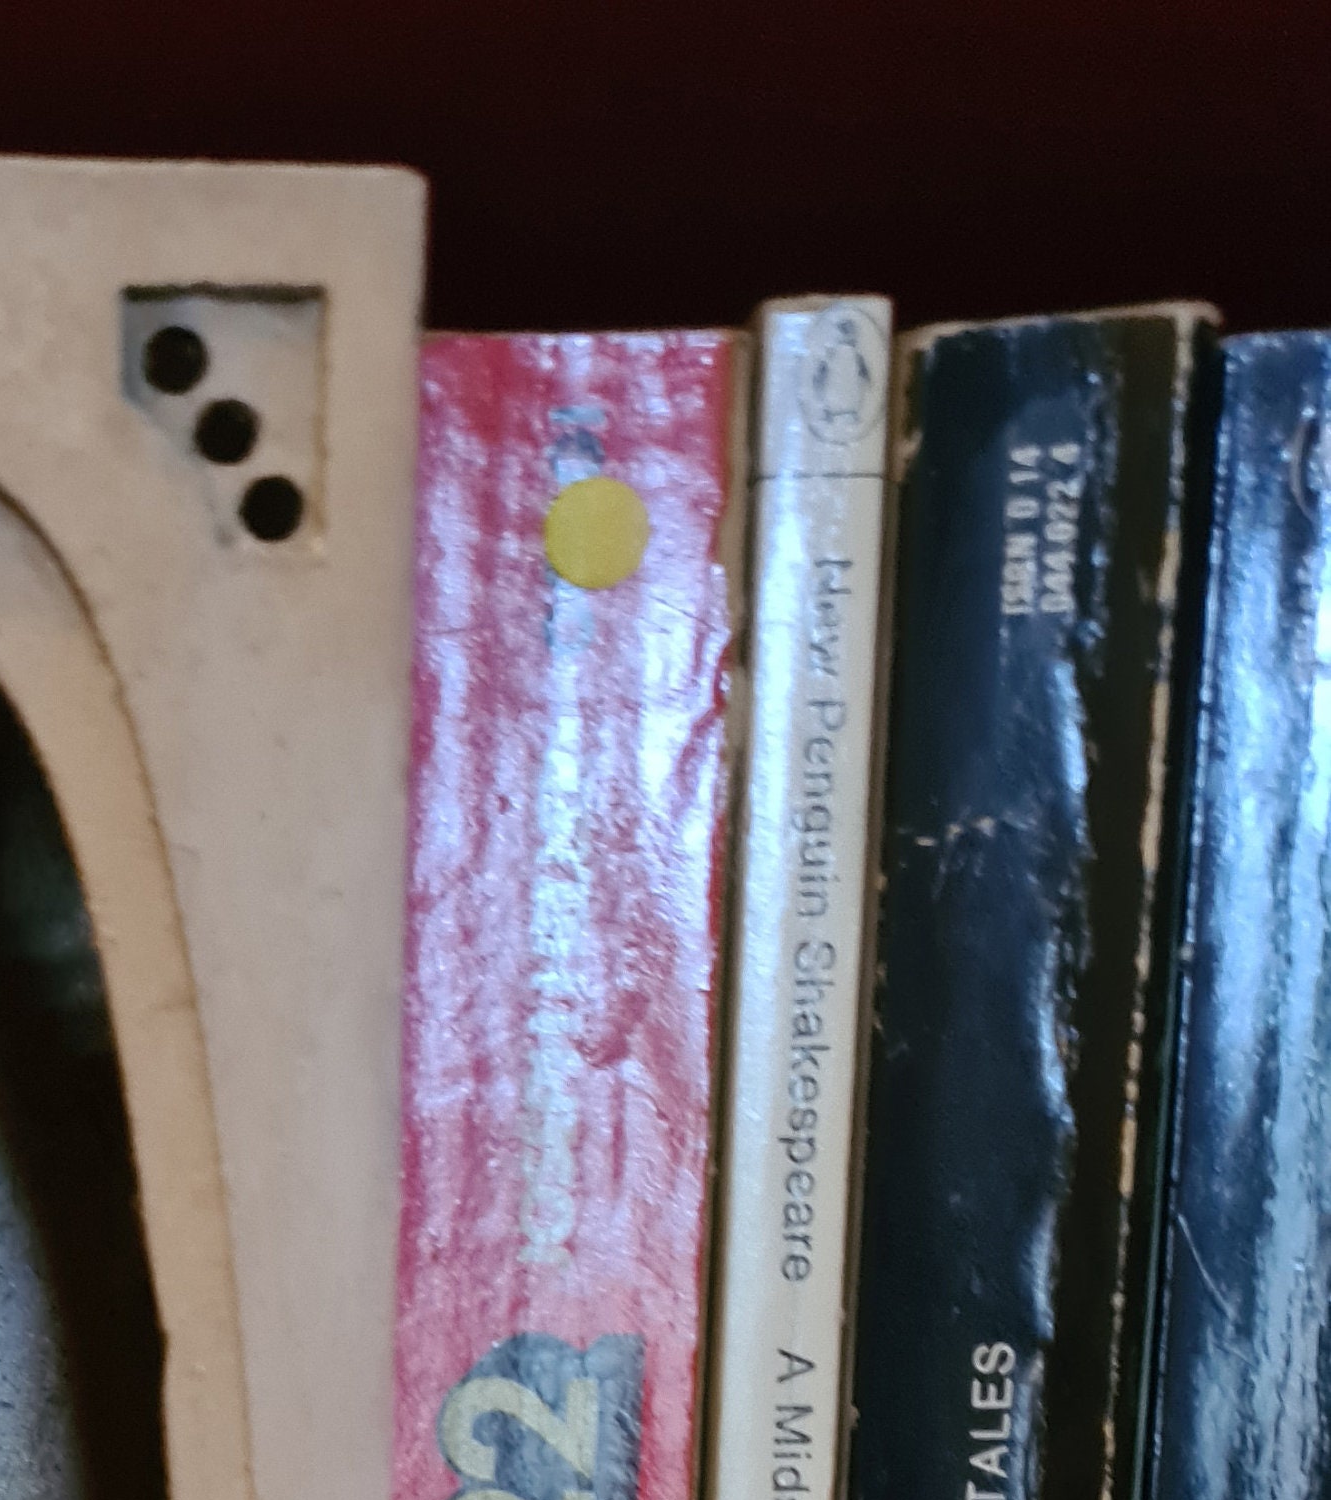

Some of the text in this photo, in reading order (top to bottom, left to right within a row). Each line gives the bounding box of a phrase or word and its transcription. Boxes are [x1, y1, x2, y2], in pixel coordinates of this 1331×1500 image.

[809, 559, 853, 677] New
[791, 700, 846, 918] Penguin
[778, 940, 837, 1282] Shakespeare
[776, 1347, 817, 1384] A
